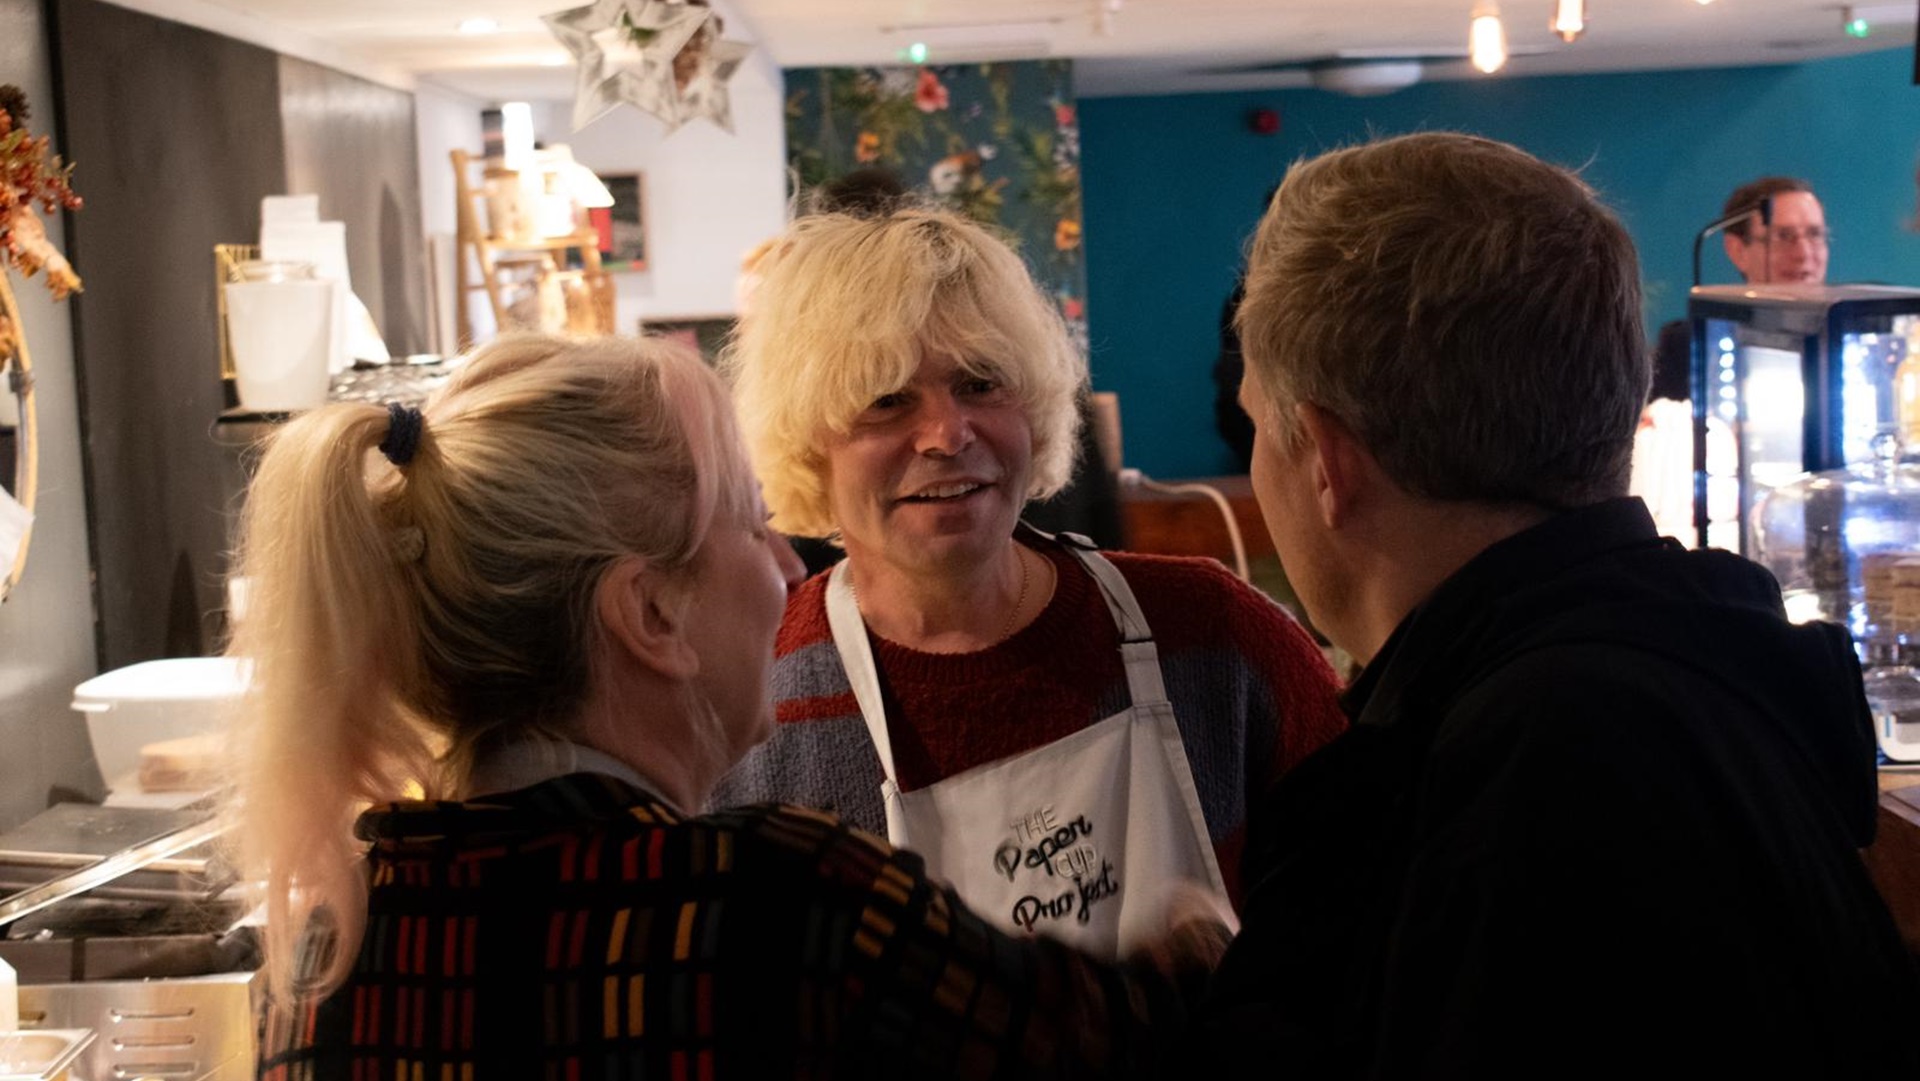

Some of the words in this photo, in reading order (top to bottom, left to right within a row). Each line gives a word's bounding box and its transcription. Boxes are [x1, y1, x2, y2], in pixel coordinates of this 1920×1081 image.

[994, 815, 1092, 883] Paper
[1010, 804, 1058, 843] THE
[1055, 844, 1097, 878] CUP
[1012, 856, 1119, 933] Project
